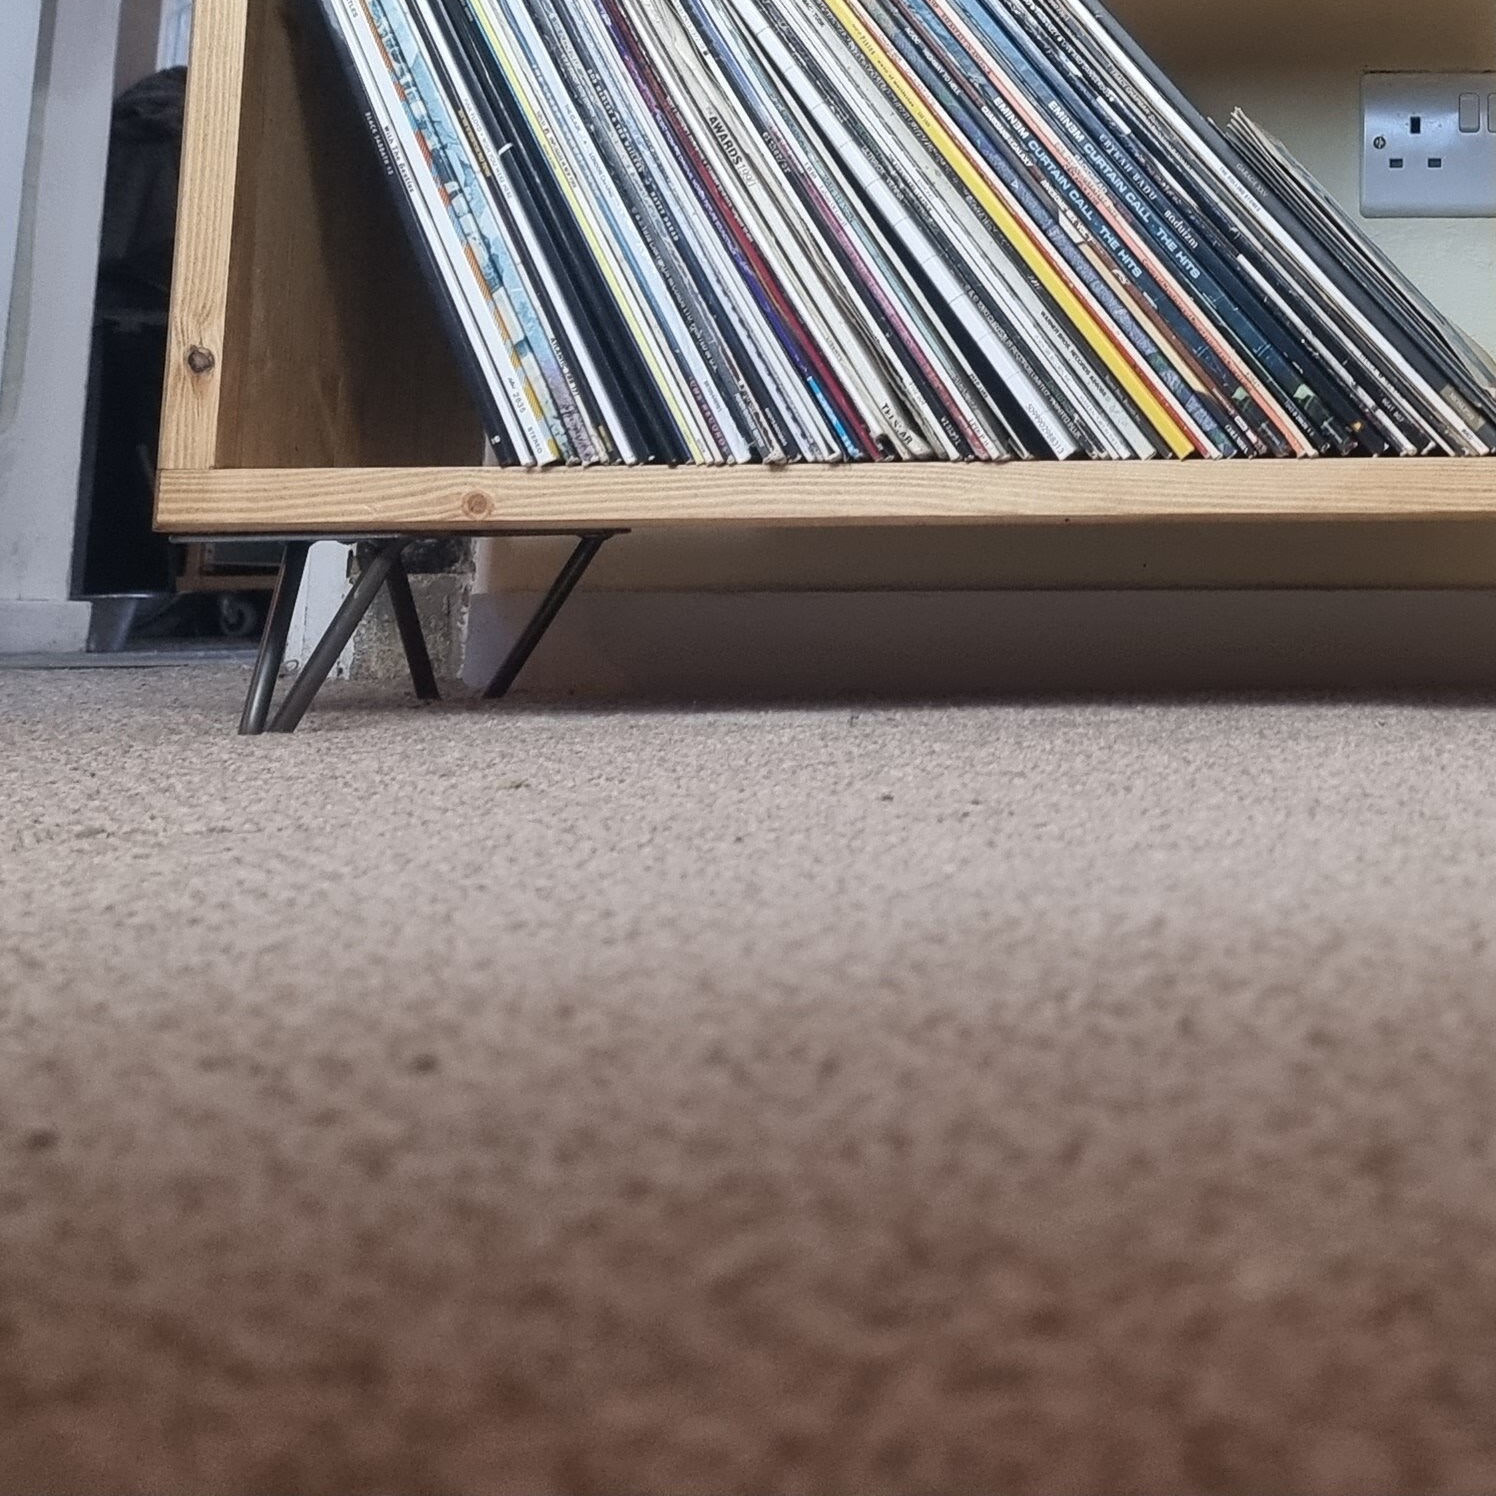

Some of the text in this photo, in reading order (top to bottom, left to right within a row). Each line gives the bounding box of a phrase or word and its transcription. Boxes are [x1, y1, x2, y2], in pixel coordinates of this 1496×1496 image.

[904, 25, 921, 44] AC/DC
[373, 134, 389, 165] SABBATH
[595, 84, 613, 114] MARLEY
[623, 140, 643, 172] WAILERS
[650, 190, 665, 214] NATTY
[663, 216, 679, 241] DREAD
[707, 114, 743, 165] AWARDS
[760, 130, 792, 174] either/or
[1097, 132, 1133, 172] ERYKAH
[1131, 173, 1157, 202] BADU
[1009, 142, 1034, 168] GALAXY
[1039, 178, 1068, 211] AWESOME
[1226, 174, 1246, 195] ROLLING
[1243, 193, 1261, 212] STONES
[1235, 162, 1258, 186] GARAGE
[1026, 138, 1071, 191] CURTAIN
[1065, 188, 1096, 222] CALL
[1096, 224, 1121, 251] THE
[1116, 248, 1143, 279] HITS
[1082, 141, 1128, 193] CURTAIN
[1123, 190, 1153, 223] CALL
[1154, 226, 1179, 252] THE
[1174, 250, 1202, 279] HITS
[1039, 309, 1060, 334] WARNER
[1068, 348, 1091, 376] RECORDS
[511, 391, 527, 413] 2835
[526, 425, 543, 454] STEREO
[1223, 423, 1250, 454] COLUMBIA
